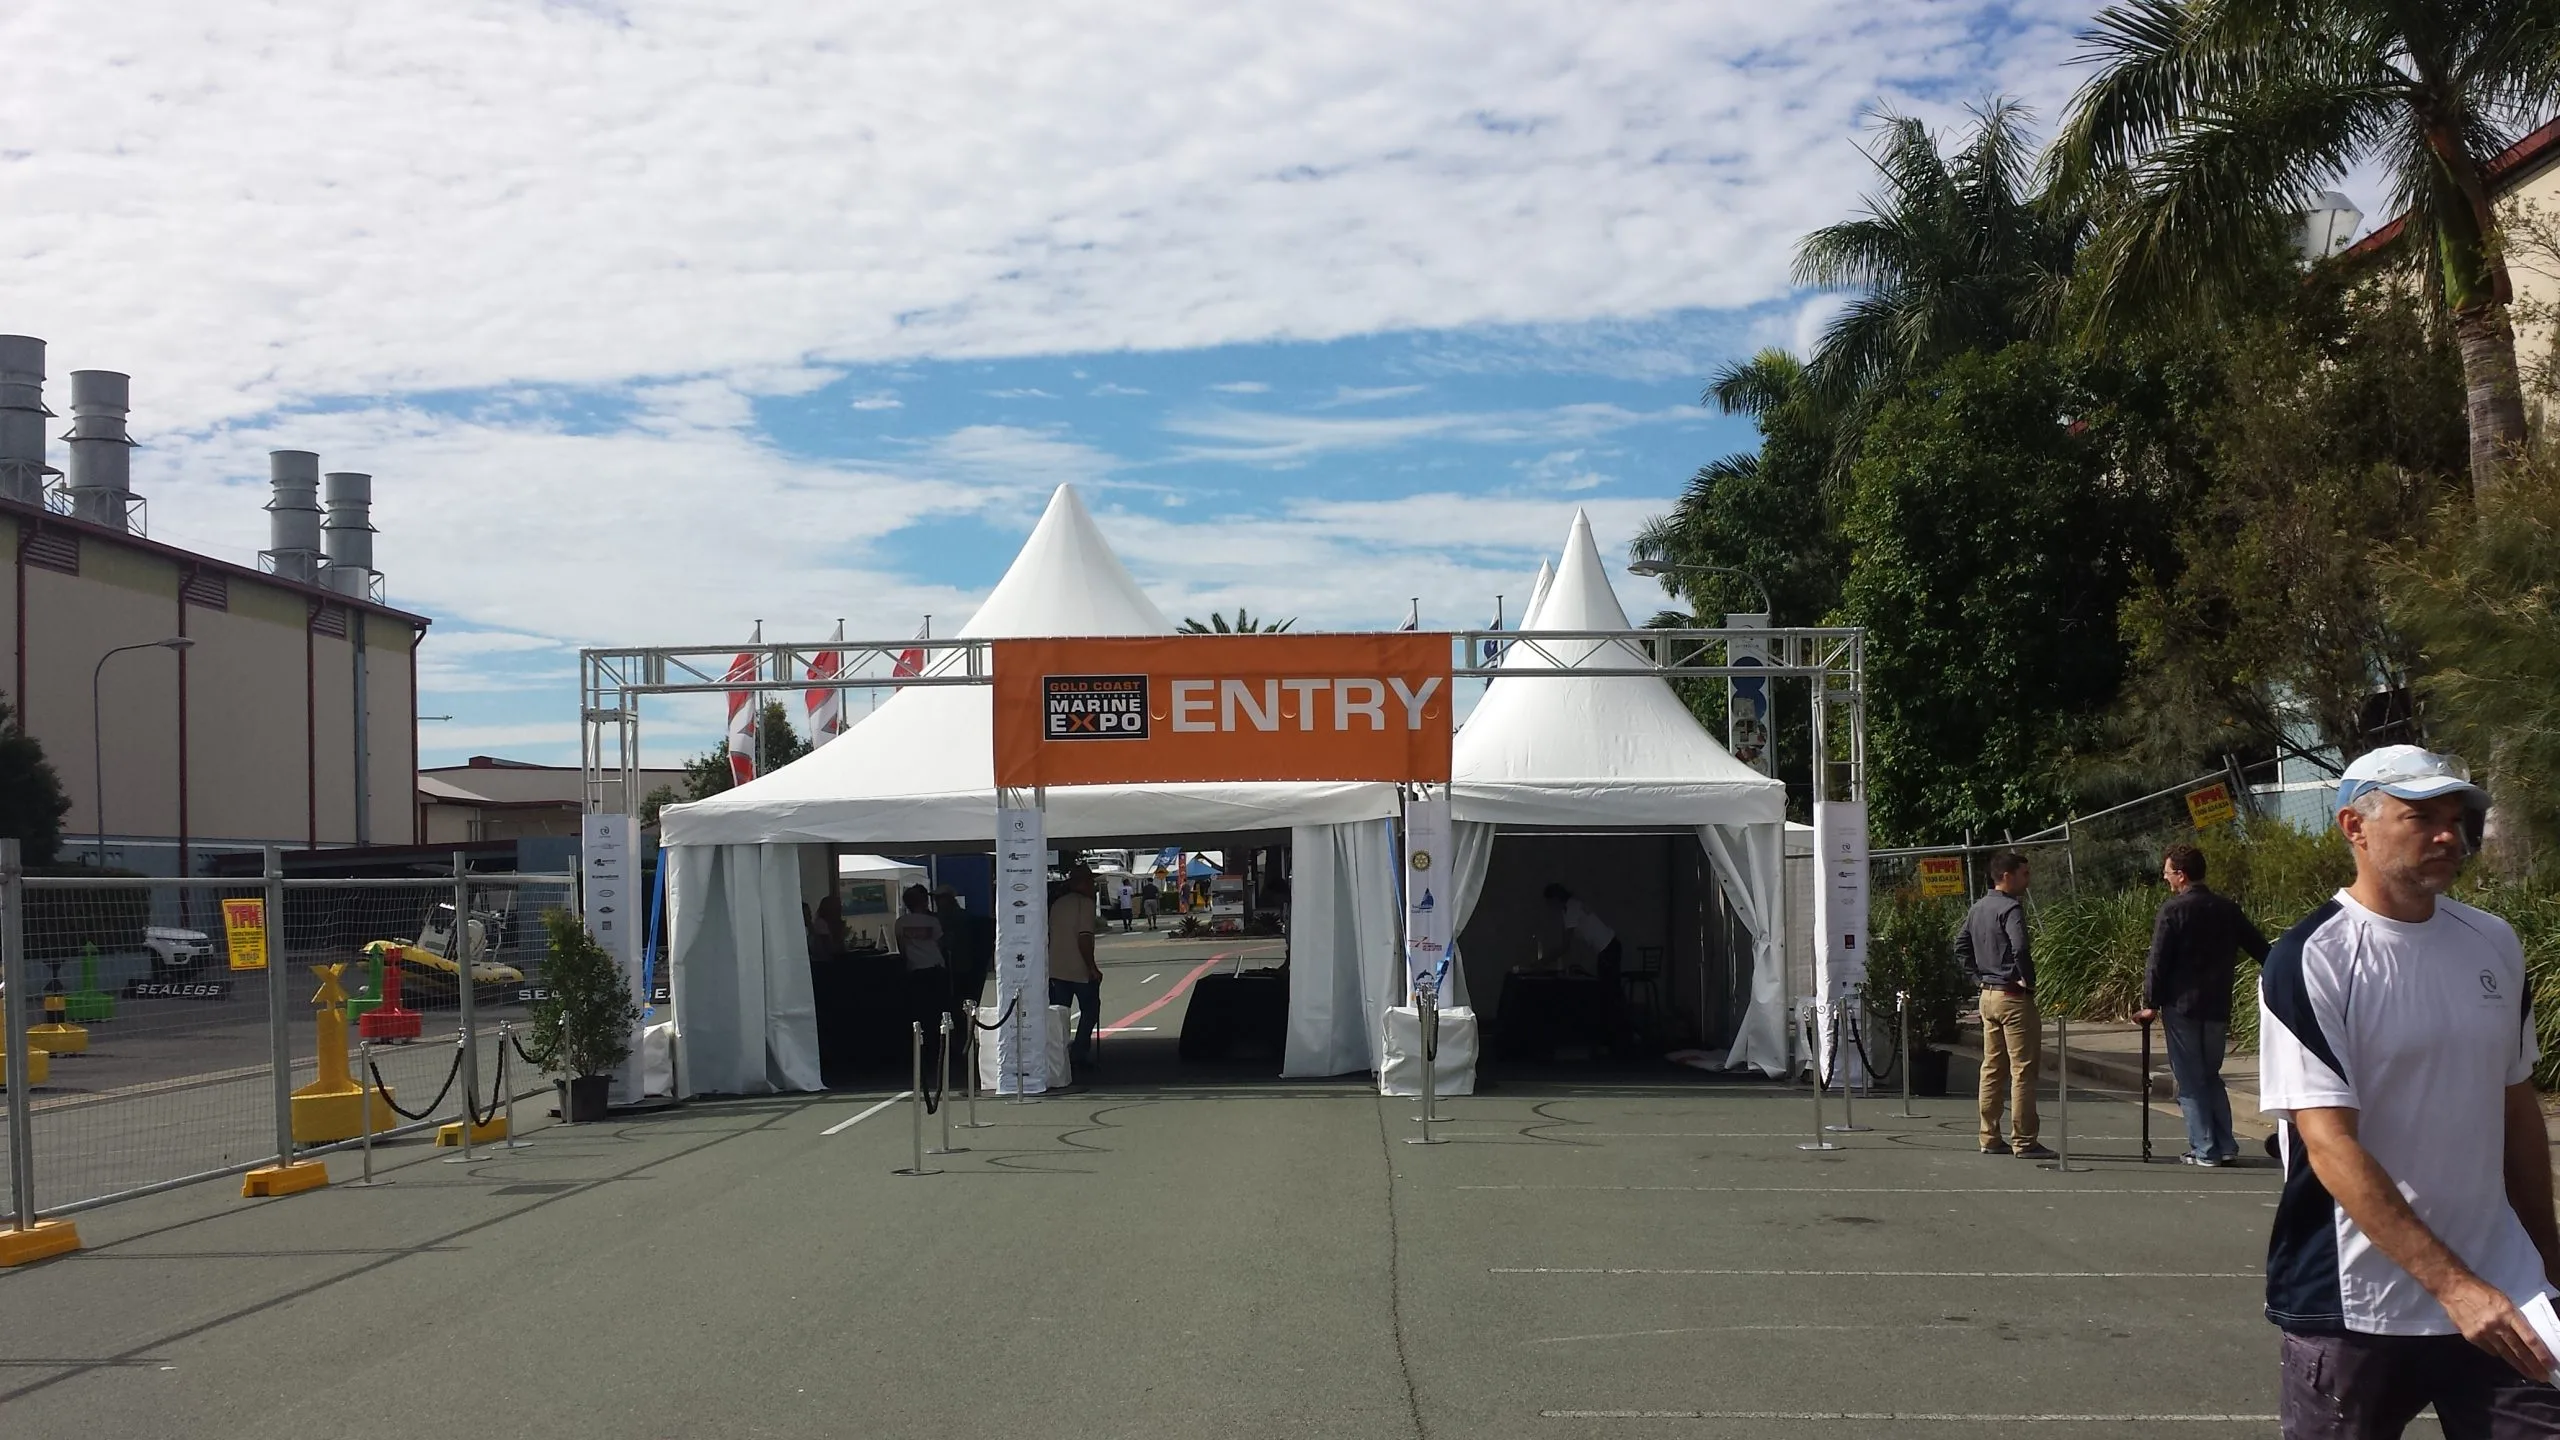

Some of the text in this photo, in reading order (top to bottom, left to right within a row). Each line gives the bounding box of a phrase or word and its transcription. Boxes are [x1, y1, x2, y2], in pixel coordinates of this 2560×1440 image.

[1049, 681, 1141, 691] GOLD COAST
[1050, 699, 1141, 713] MARINE
[1171, 677, 1443, 732] ENTRY
[1050, 713, 1141, 732] EXPO
[136, 984, 220, 996] SEALEGS
